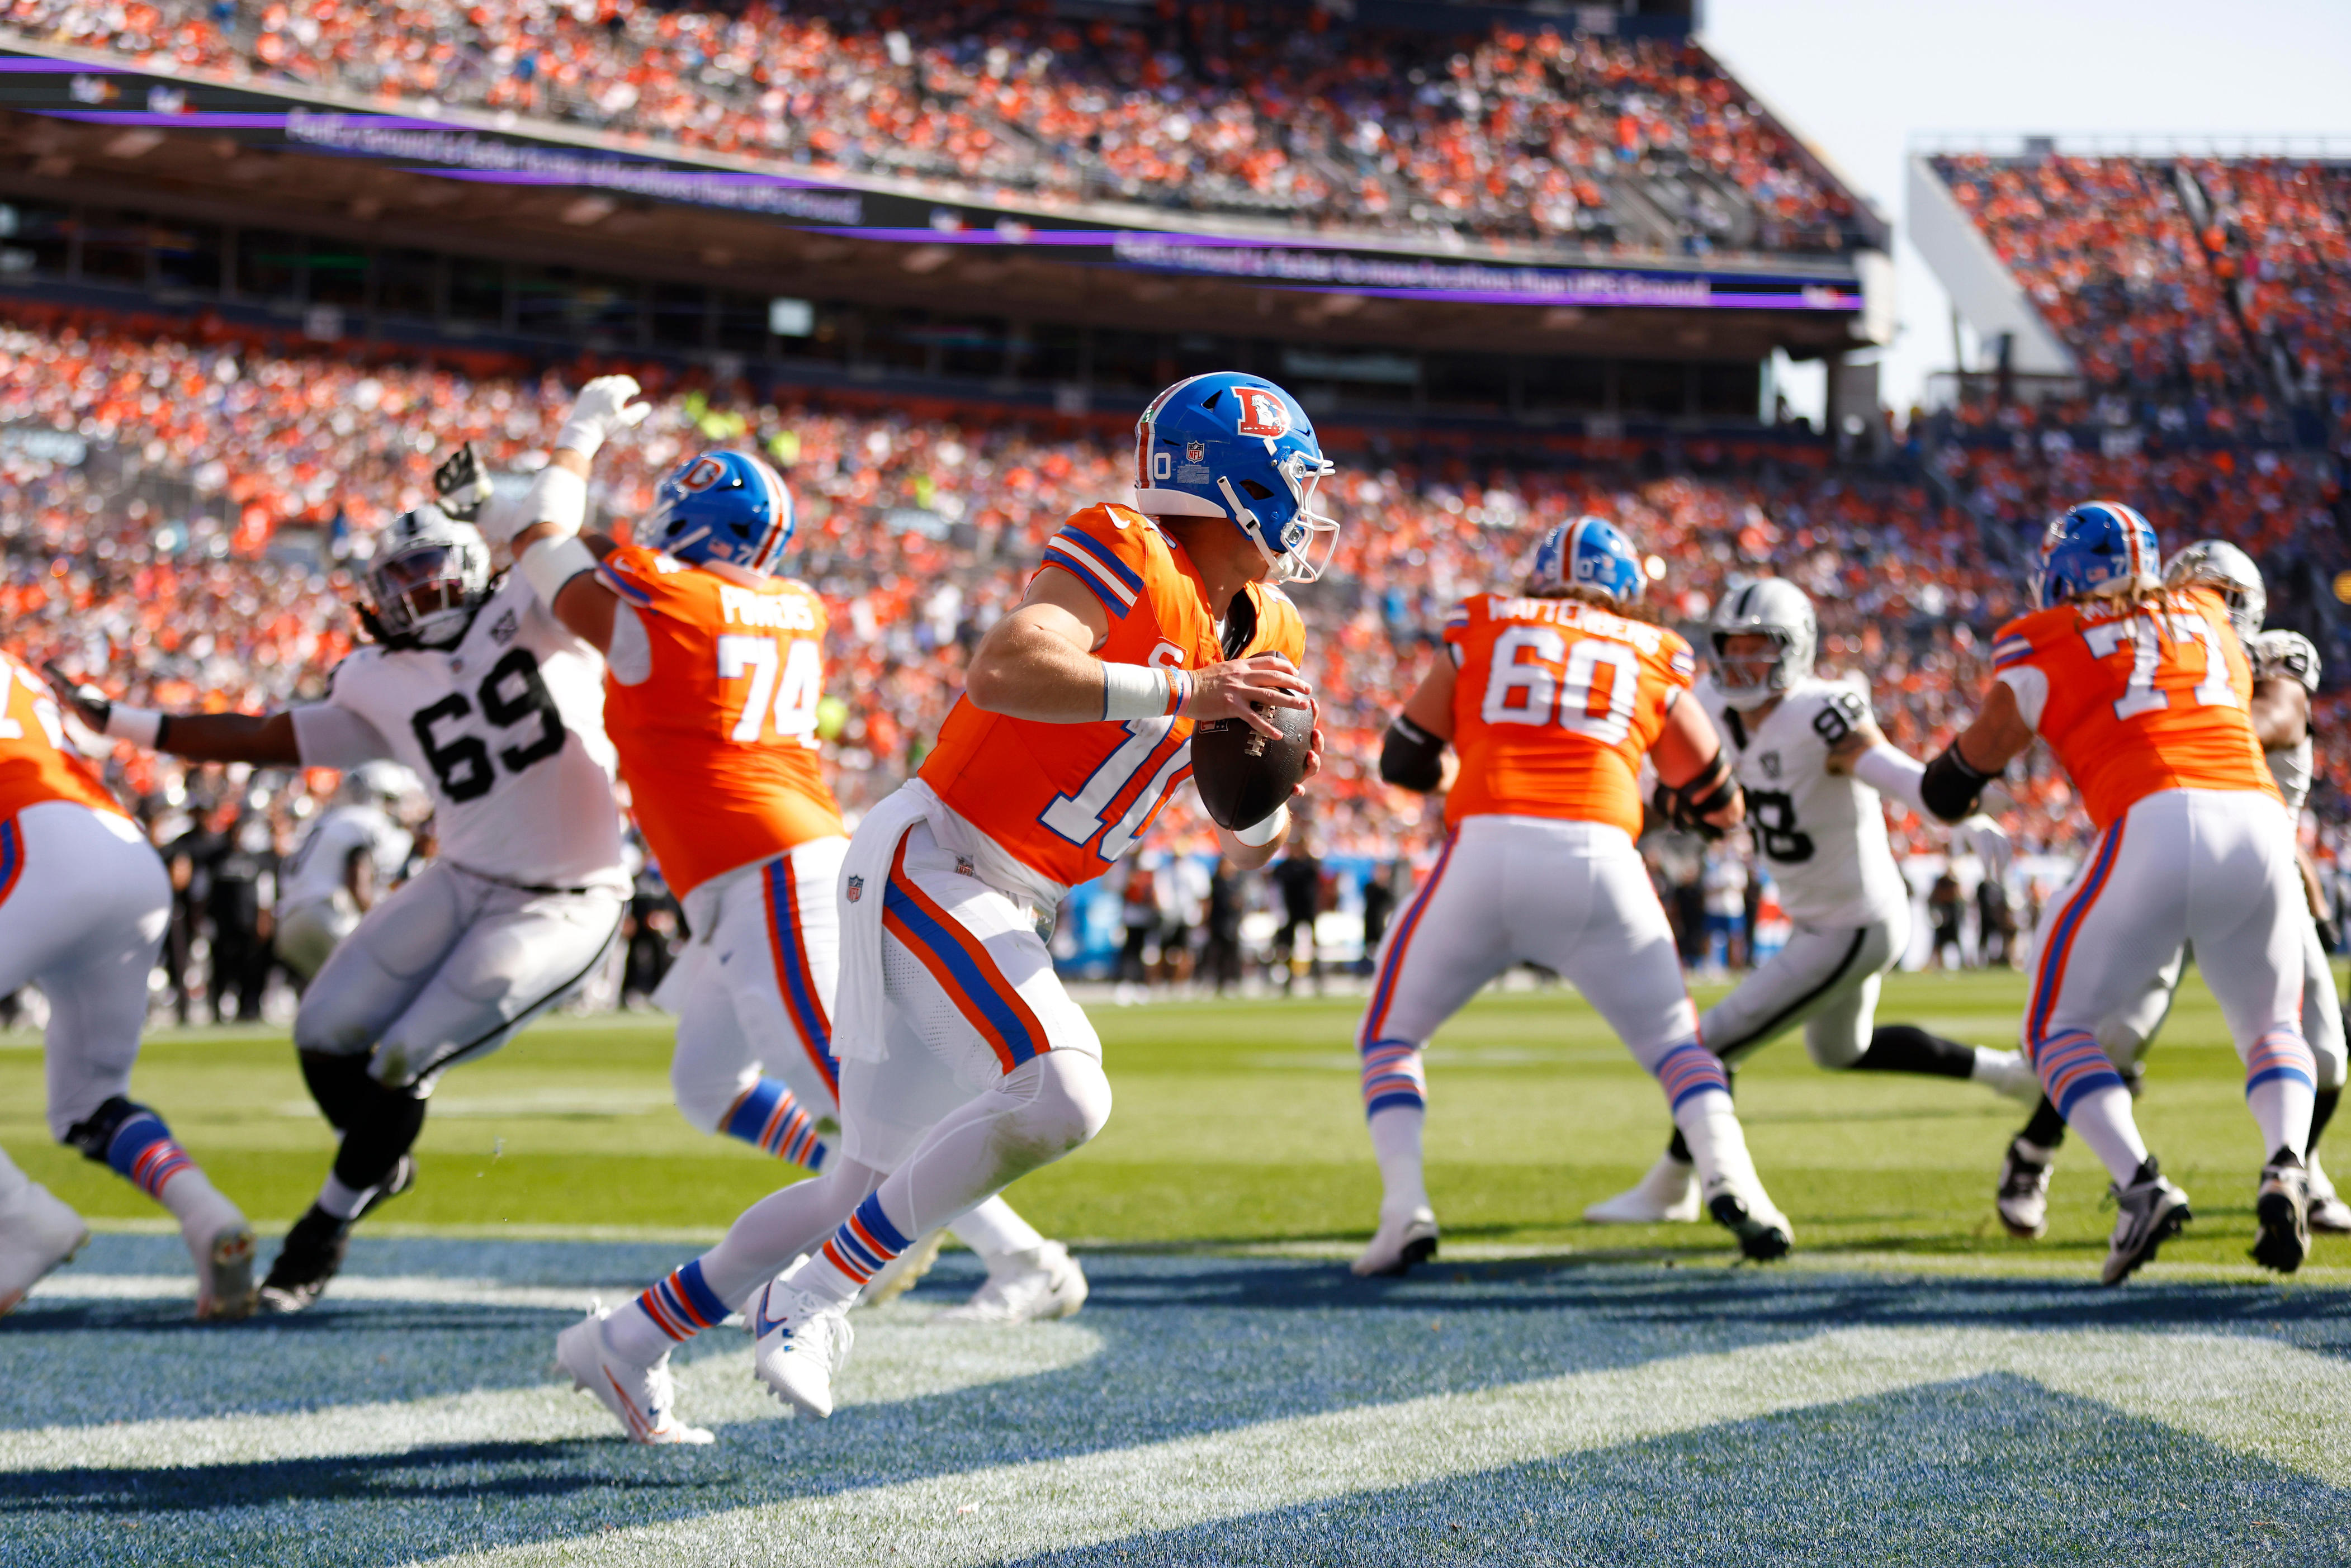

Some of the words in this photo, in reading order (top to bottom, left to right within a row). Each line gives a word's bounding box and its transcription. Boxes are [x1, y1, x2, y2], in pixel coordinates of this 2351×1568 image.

[1188, 450, 1201, 459] NFL
[718, 636, 822, 748] 74
[1480, 624, 1640, 747] 60
[2082, 613, 2239, 721] 77
[410, 647, 566, 805] 69
